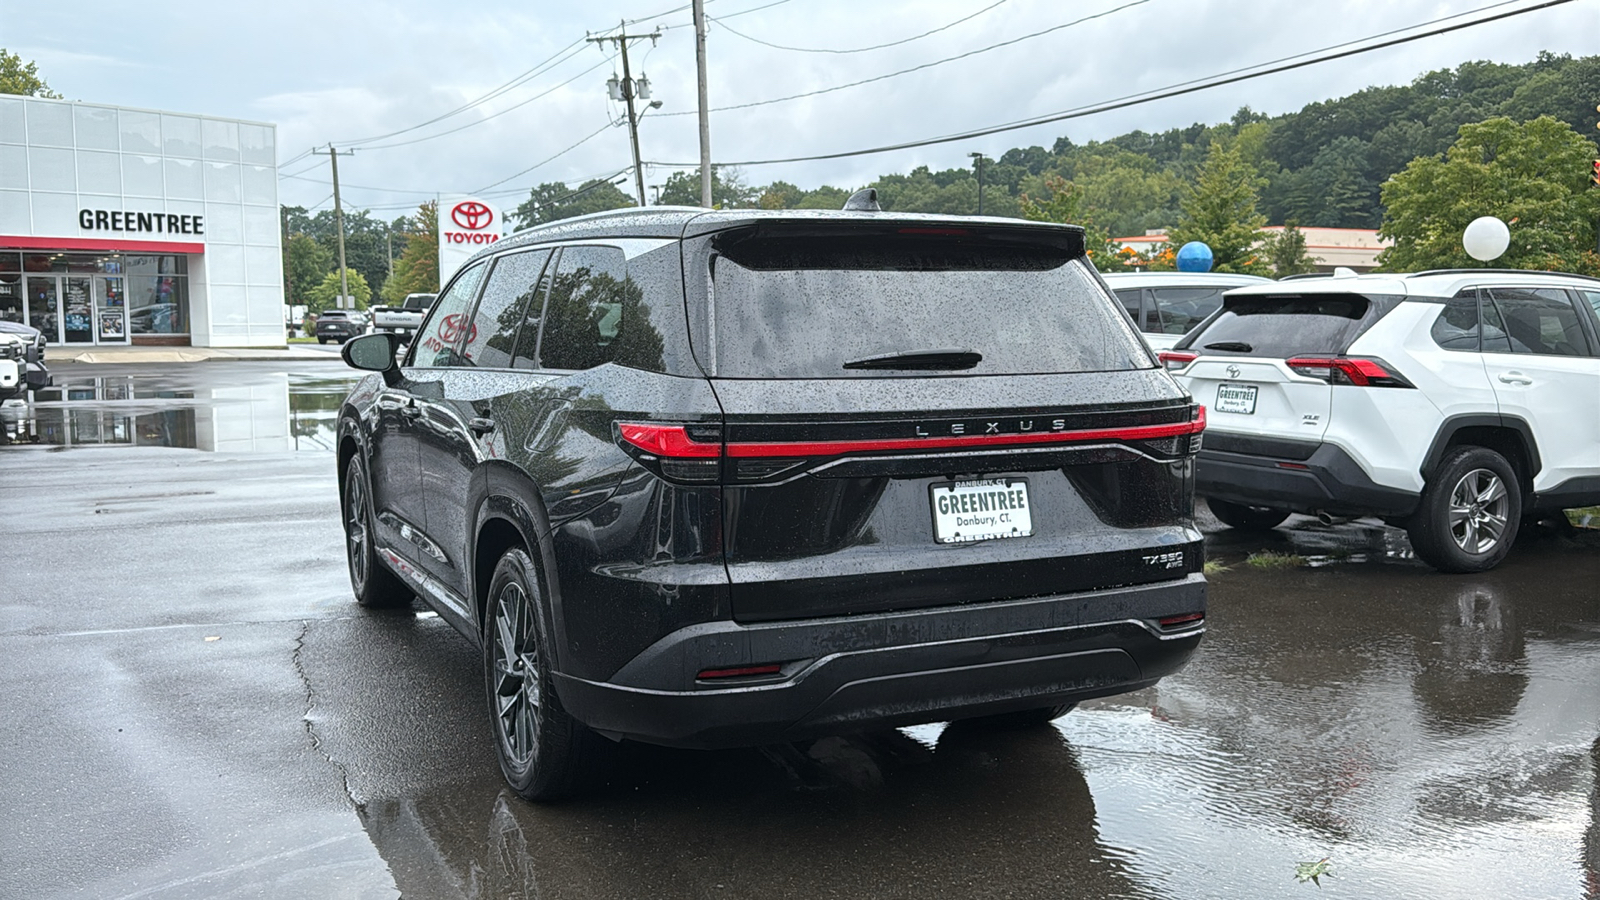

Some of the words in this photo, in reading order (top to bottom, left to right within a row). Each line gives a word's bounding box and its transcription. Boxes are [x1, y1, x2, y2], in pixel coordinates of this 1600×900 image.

[79, 209, 204, 235] GREENTREE
[444, 232, 499, 244] TOYOTA
[1220, 390, 1254, 401] GREENTREE
[916, 419, 1065, 436] LEXUS
[938, 490, 1025, 515] GREENTREE
[957, 515, 997, 526] Danbury,
[1000, 513, 1012, 523] CT.
